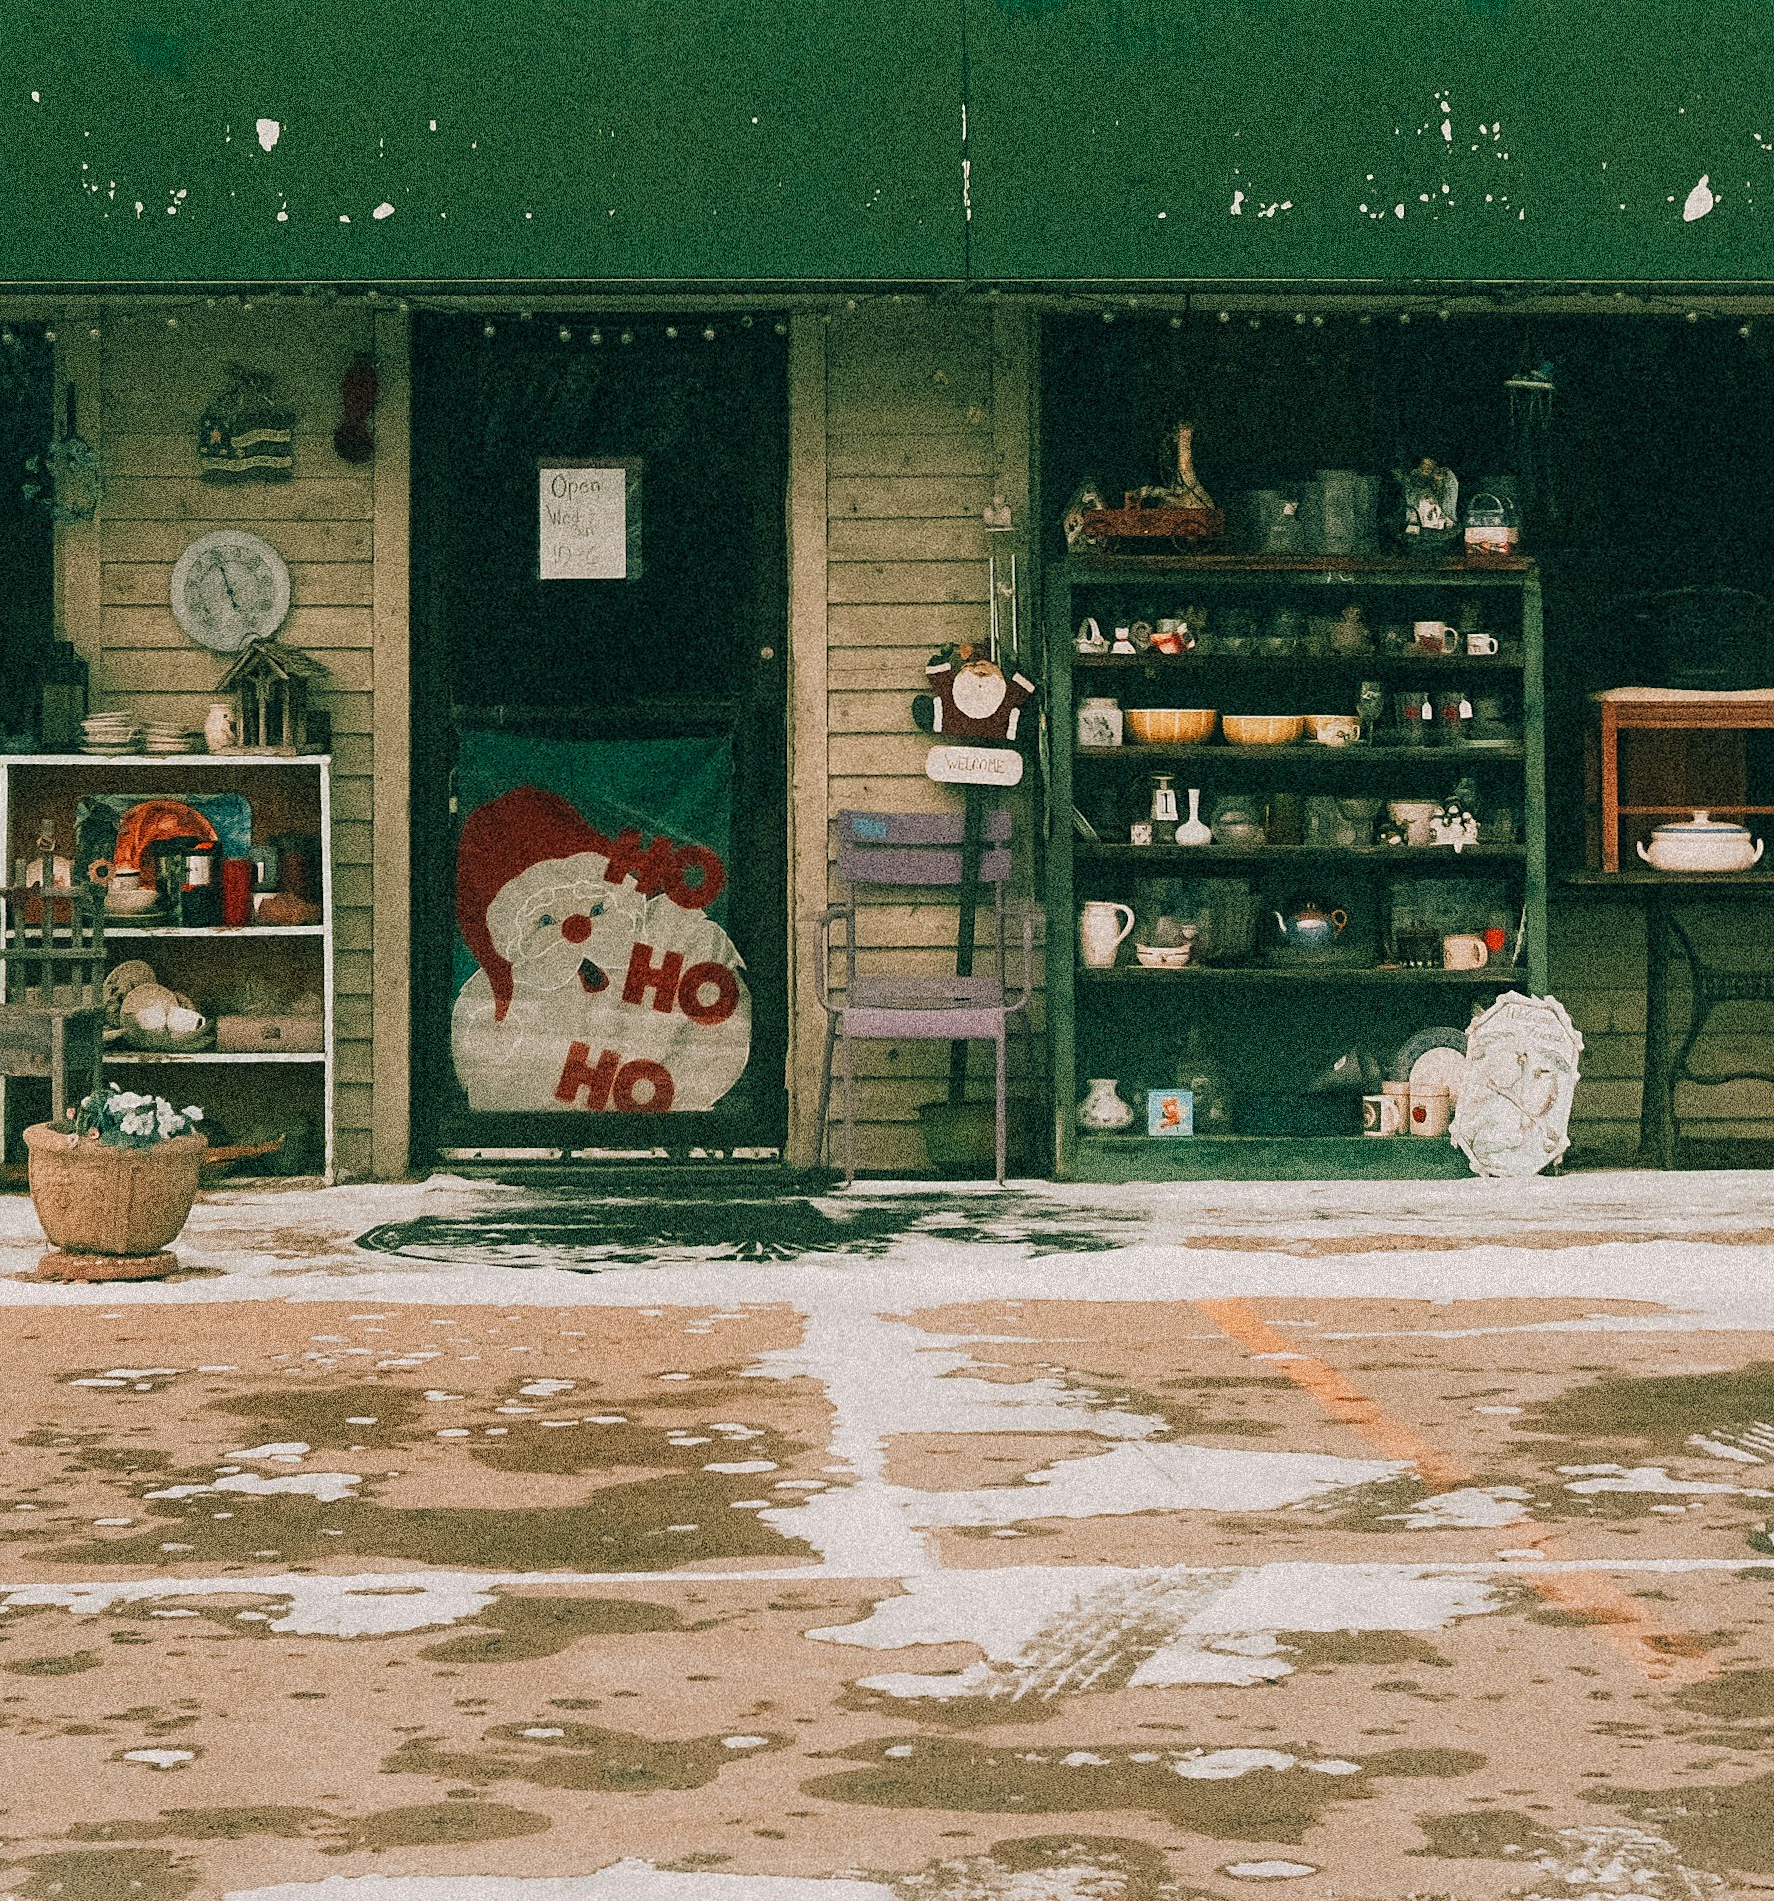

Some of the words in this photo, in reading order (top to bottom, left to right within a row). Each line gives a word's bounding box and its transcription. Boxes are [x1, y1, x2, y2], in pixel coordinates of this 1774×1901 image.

[551, 474, 601, 500] Open
[944, 753, 1005, 774] WELCOME
[603, 828, 726, 910] HO
[621, 942, 740, 1026] HO
[554, 1041, 675, 1112] HO
